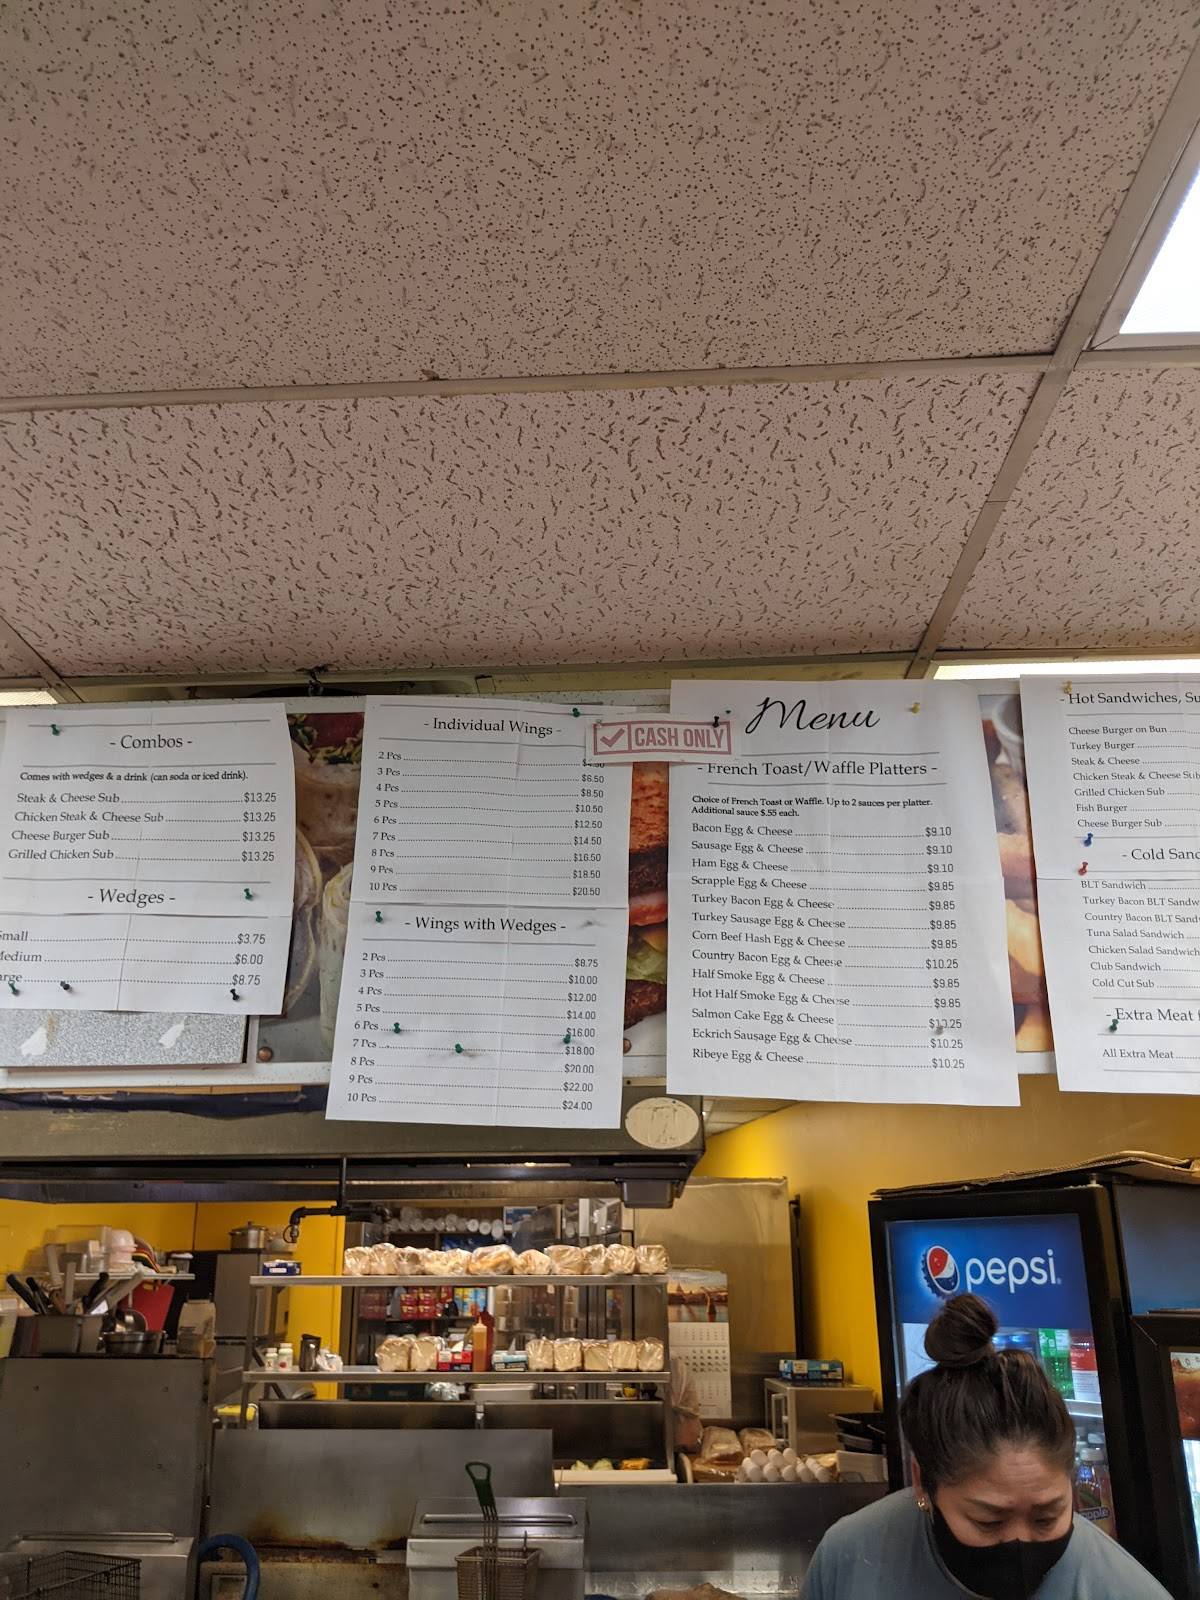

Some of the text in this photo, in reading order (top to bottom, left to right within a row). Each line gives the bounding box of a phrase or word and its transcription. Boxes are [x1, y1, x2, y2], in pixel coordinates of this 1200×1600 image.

[1068, 691, 1094, 704] Hot
[1098, 692, 1181, 704] Sandwiches,
[745, 697, 880, 734] Menu
[434, 718, 552, 738] Individual Wings
[1069, 727, 1101, 736] Cheese
[1102, 726, 1133, 736] Burger
[1149, 725, 1167, 733] Bun
[120, 734, 183, 750] Combos
[635, 728, 724, 748] CASH ONLY
[1070, 742, 1135, 751] Turkey Burger
[707, 760, 926, 776] French Toast/Waffle Platters
[1071, 756, 1140, 767] Steak & Cheese
[20, 772, 50, 781] Comes
[52, 772, 70, 780] with
[72, 771, 104, 782] wedges
[123, 773, 148, 781] drink
[169, 772, 189, 780] soda
[202, 771, 219, 780] iced
[17, 792, 276, 804] Steak & Cheese Sub $13.25
[1074, 787, 1165, 797] Grilled Chicken Sub
[383, 800, 399, 808] Pcs
[575, 804, 603, 813] $10.50
[692, 795, 720, 803] Choice
[731, 797, 758, 806] French
[760, 798, 782, 806] Toast
[795, 797, 824, 805] Waffle.
[827, 797, 840, 807] Up
[902, 799, 932, 808] platter.
[691, 806, 734, 815] Additional
[1076, 804, 1128, 814] Fish Burger
[15, 811, 275, 823] Chicken Steak & Cheese Sub $13.25
[382, 816, 397, 824] Pcs
[574, 819, 602, 829] $12.50
[1078, 818, 1162, 829] Cheese Burger Sub
[692, 823, 721, 832] Bacon
[725, 824, 744, 836] Egg
[745, 826, 754, 835] &
[757, 826, 792, 836] Cheese
[11, 830, 275, 843] Cheese Burger Sub $13.25
[692, 841, 732, 853] Sausage
[735, 842, 754, 855] Egg
[767, 844, 803, 853] Cheese
[1131, 848, 1165, 860] Cold
[8, 849, 274, 862] Grilled Chicken Sub $13.25
[692, 858, 716, 867] Ham
[720, 859, 739, 872] Egg
[740, 860, 750, 869] &
[753, 861, 790, 871] Cheese
[370, 882, 600, 896] 10 Pcs $20.50
[691, 876, 954, 892] Scrapple Egg & Cheese $9.85
[1101, 879, 1147, 889] Sandwich
[100, 889, 164, 908] Wedges
[416, 917, 556, 935] Wings with Wedges
[236, 933, 265, 946] $3.75
[1113, 929, 1138, 937] Salad
[1140, 928, 1184, 939] Sandwich
[1089, 945, 1127, 954] Chicken
[1127, 945, 1154, 955] Salad
[233, 953, 263, 966] $6.00
[1090, 962, 1161, 971] Club Sandwich
[360, 969, 597, 985] 3 Pcs $10.00
[692, 968, 960, 989] Half Smoke Egg & Cheese $9.85
[1092, 978, 1154, 988] Cold Cut Sub
[367, 986, 382, 995] Pcs
[568, 992, 596, 1003] $12.00
[1115, 1008, 1193, 1021] Extra Meat
[692, 1048, 964, 1069] Ribeye Egg & Cheese $10.25
[1103, 1048, 1174, 1060] All Extra Meat
[349, 1074, 593, 1093] 9 Pcs $22.00
[966, 1249, 1056, 1294] pepsi
